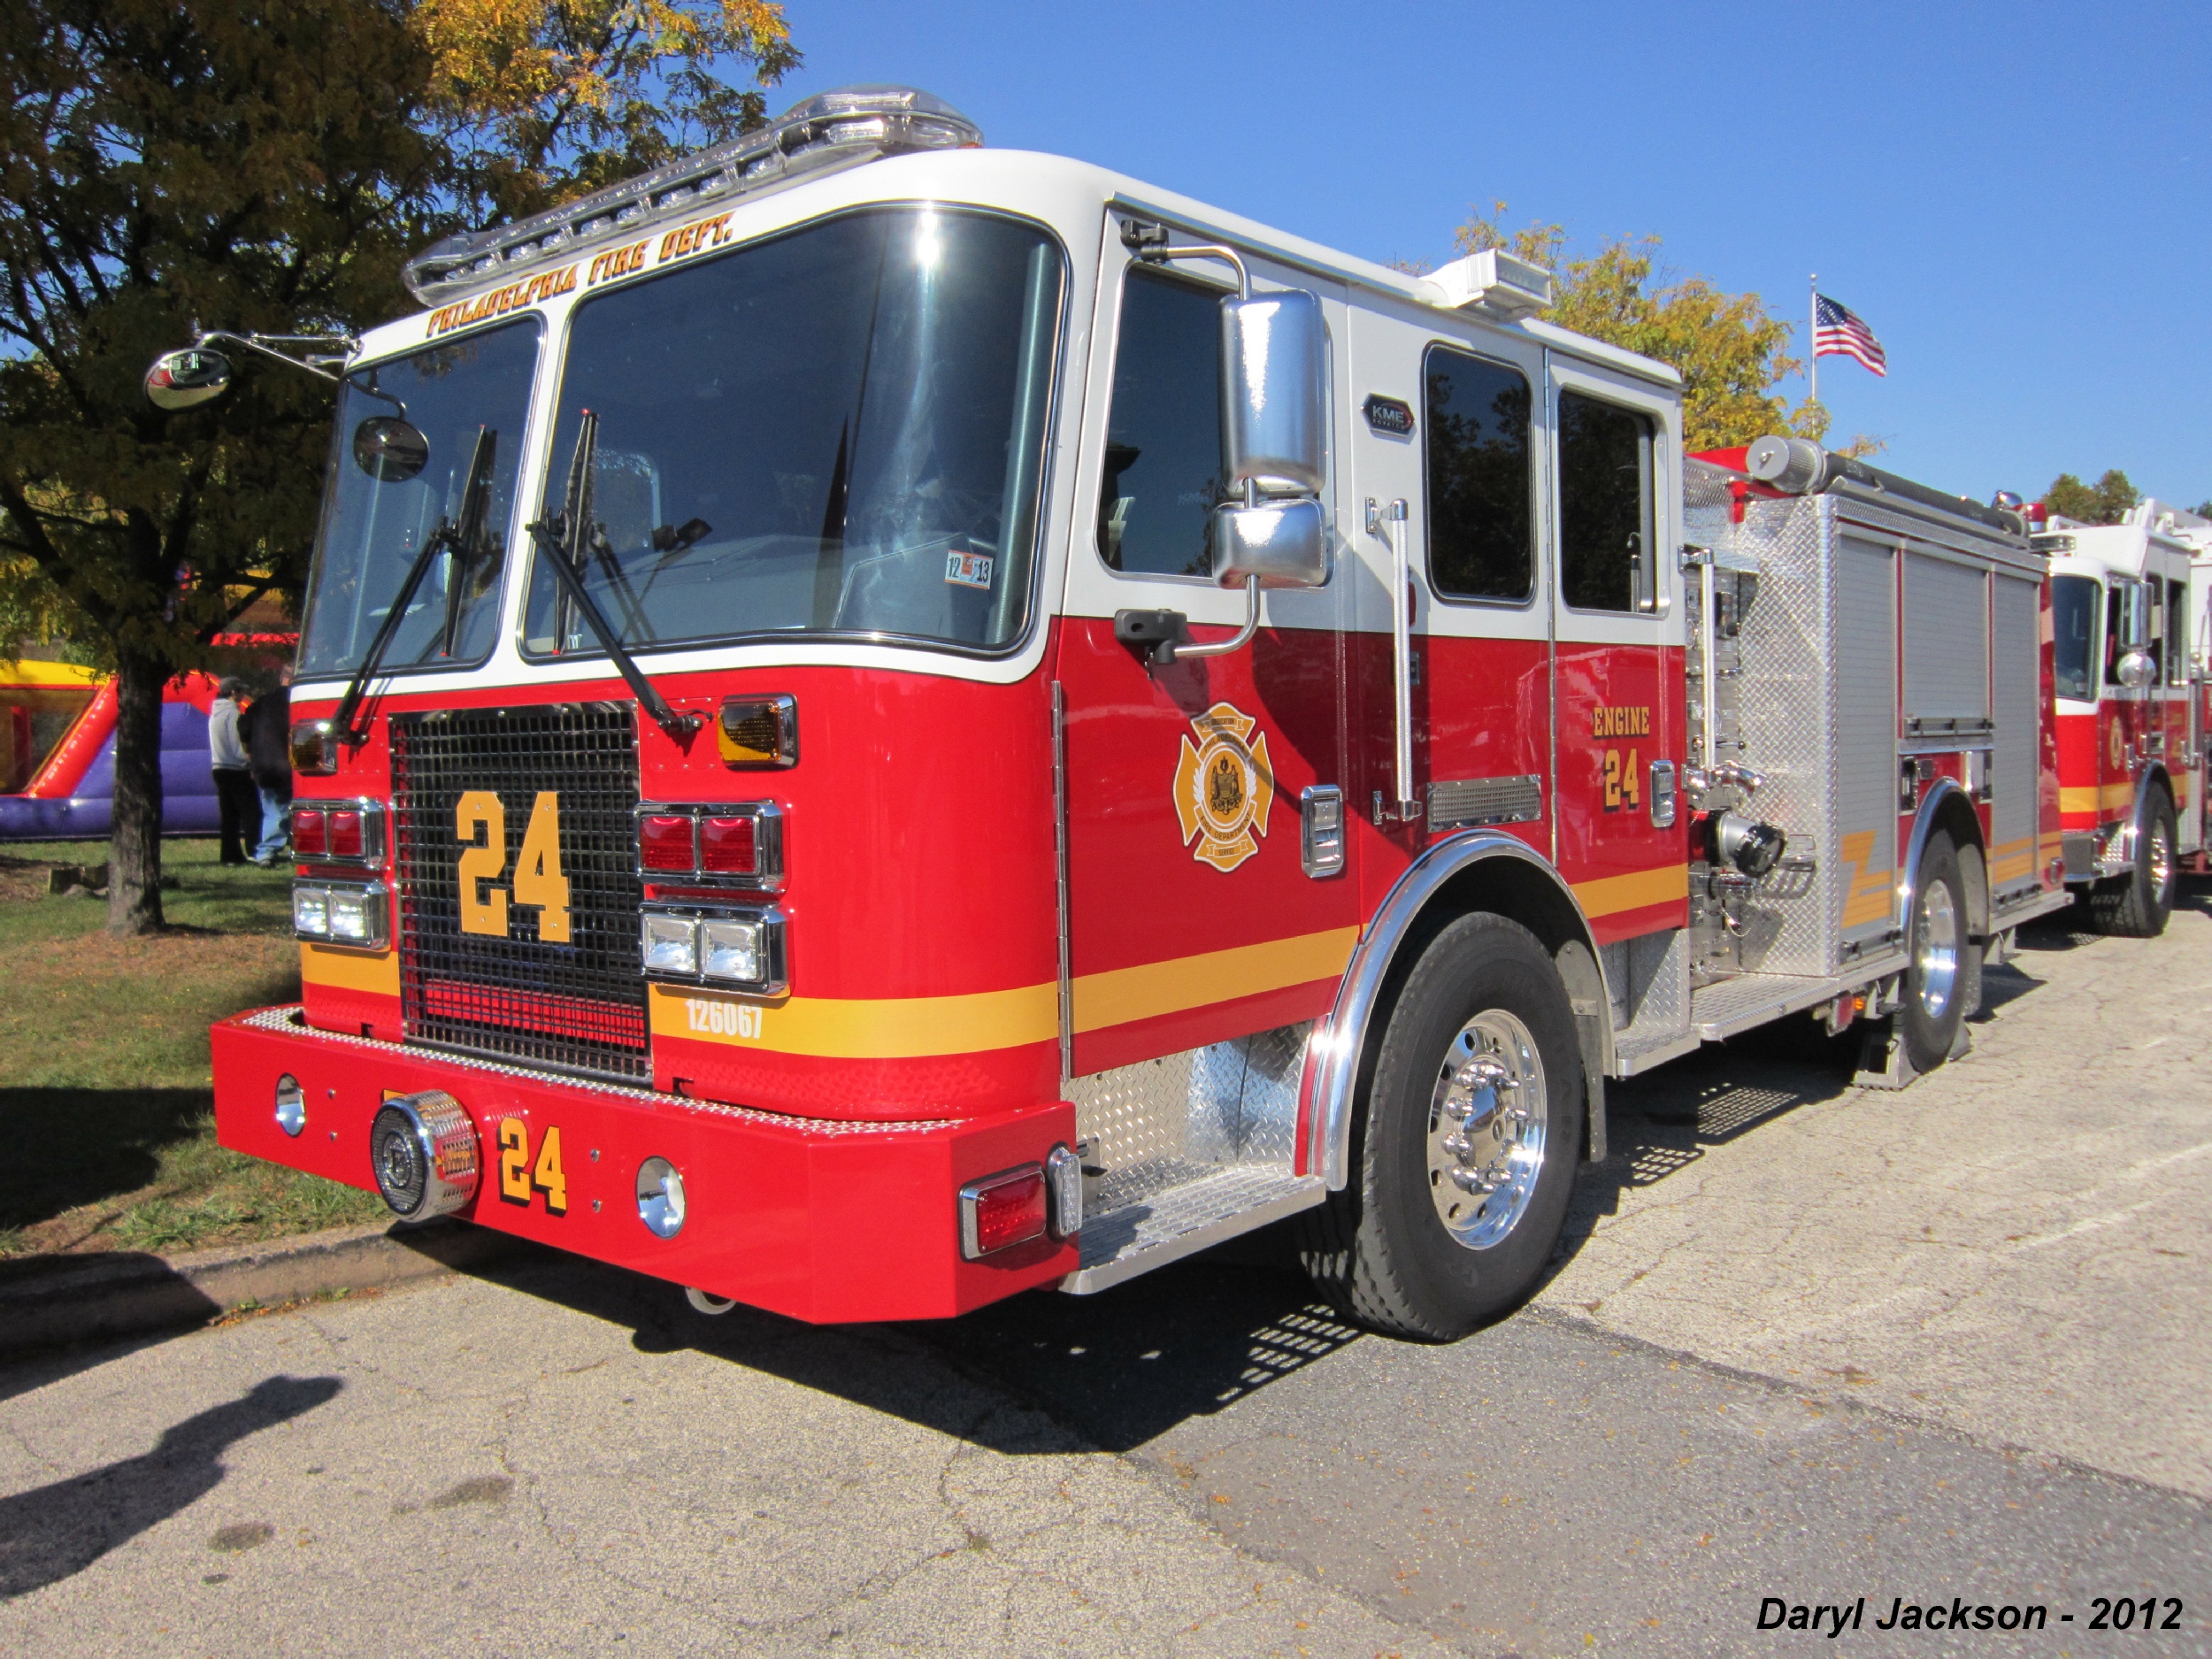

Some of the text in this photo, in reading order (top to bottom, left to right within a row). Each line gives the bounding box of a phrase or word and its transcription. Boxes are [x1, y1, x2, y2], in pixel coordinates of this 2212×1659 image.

[426, 211, 737, 339] PHILADELPHIA FIRE DEPT.
[1372, 404, 1405, 424] KME
[949, 557, 962, 579] 12
[977, 560, 990, 583] 13
[1593, 706, 1650, 739] ENGINE
[1603, 748, 1640, 812] 24
[1214, 812, 1251, 841] DEPARTMENT
[457, 790, 571, 943] 24
[685, 996, 763, 1040] 126067
[496, 1116, 567, 1218] 24
